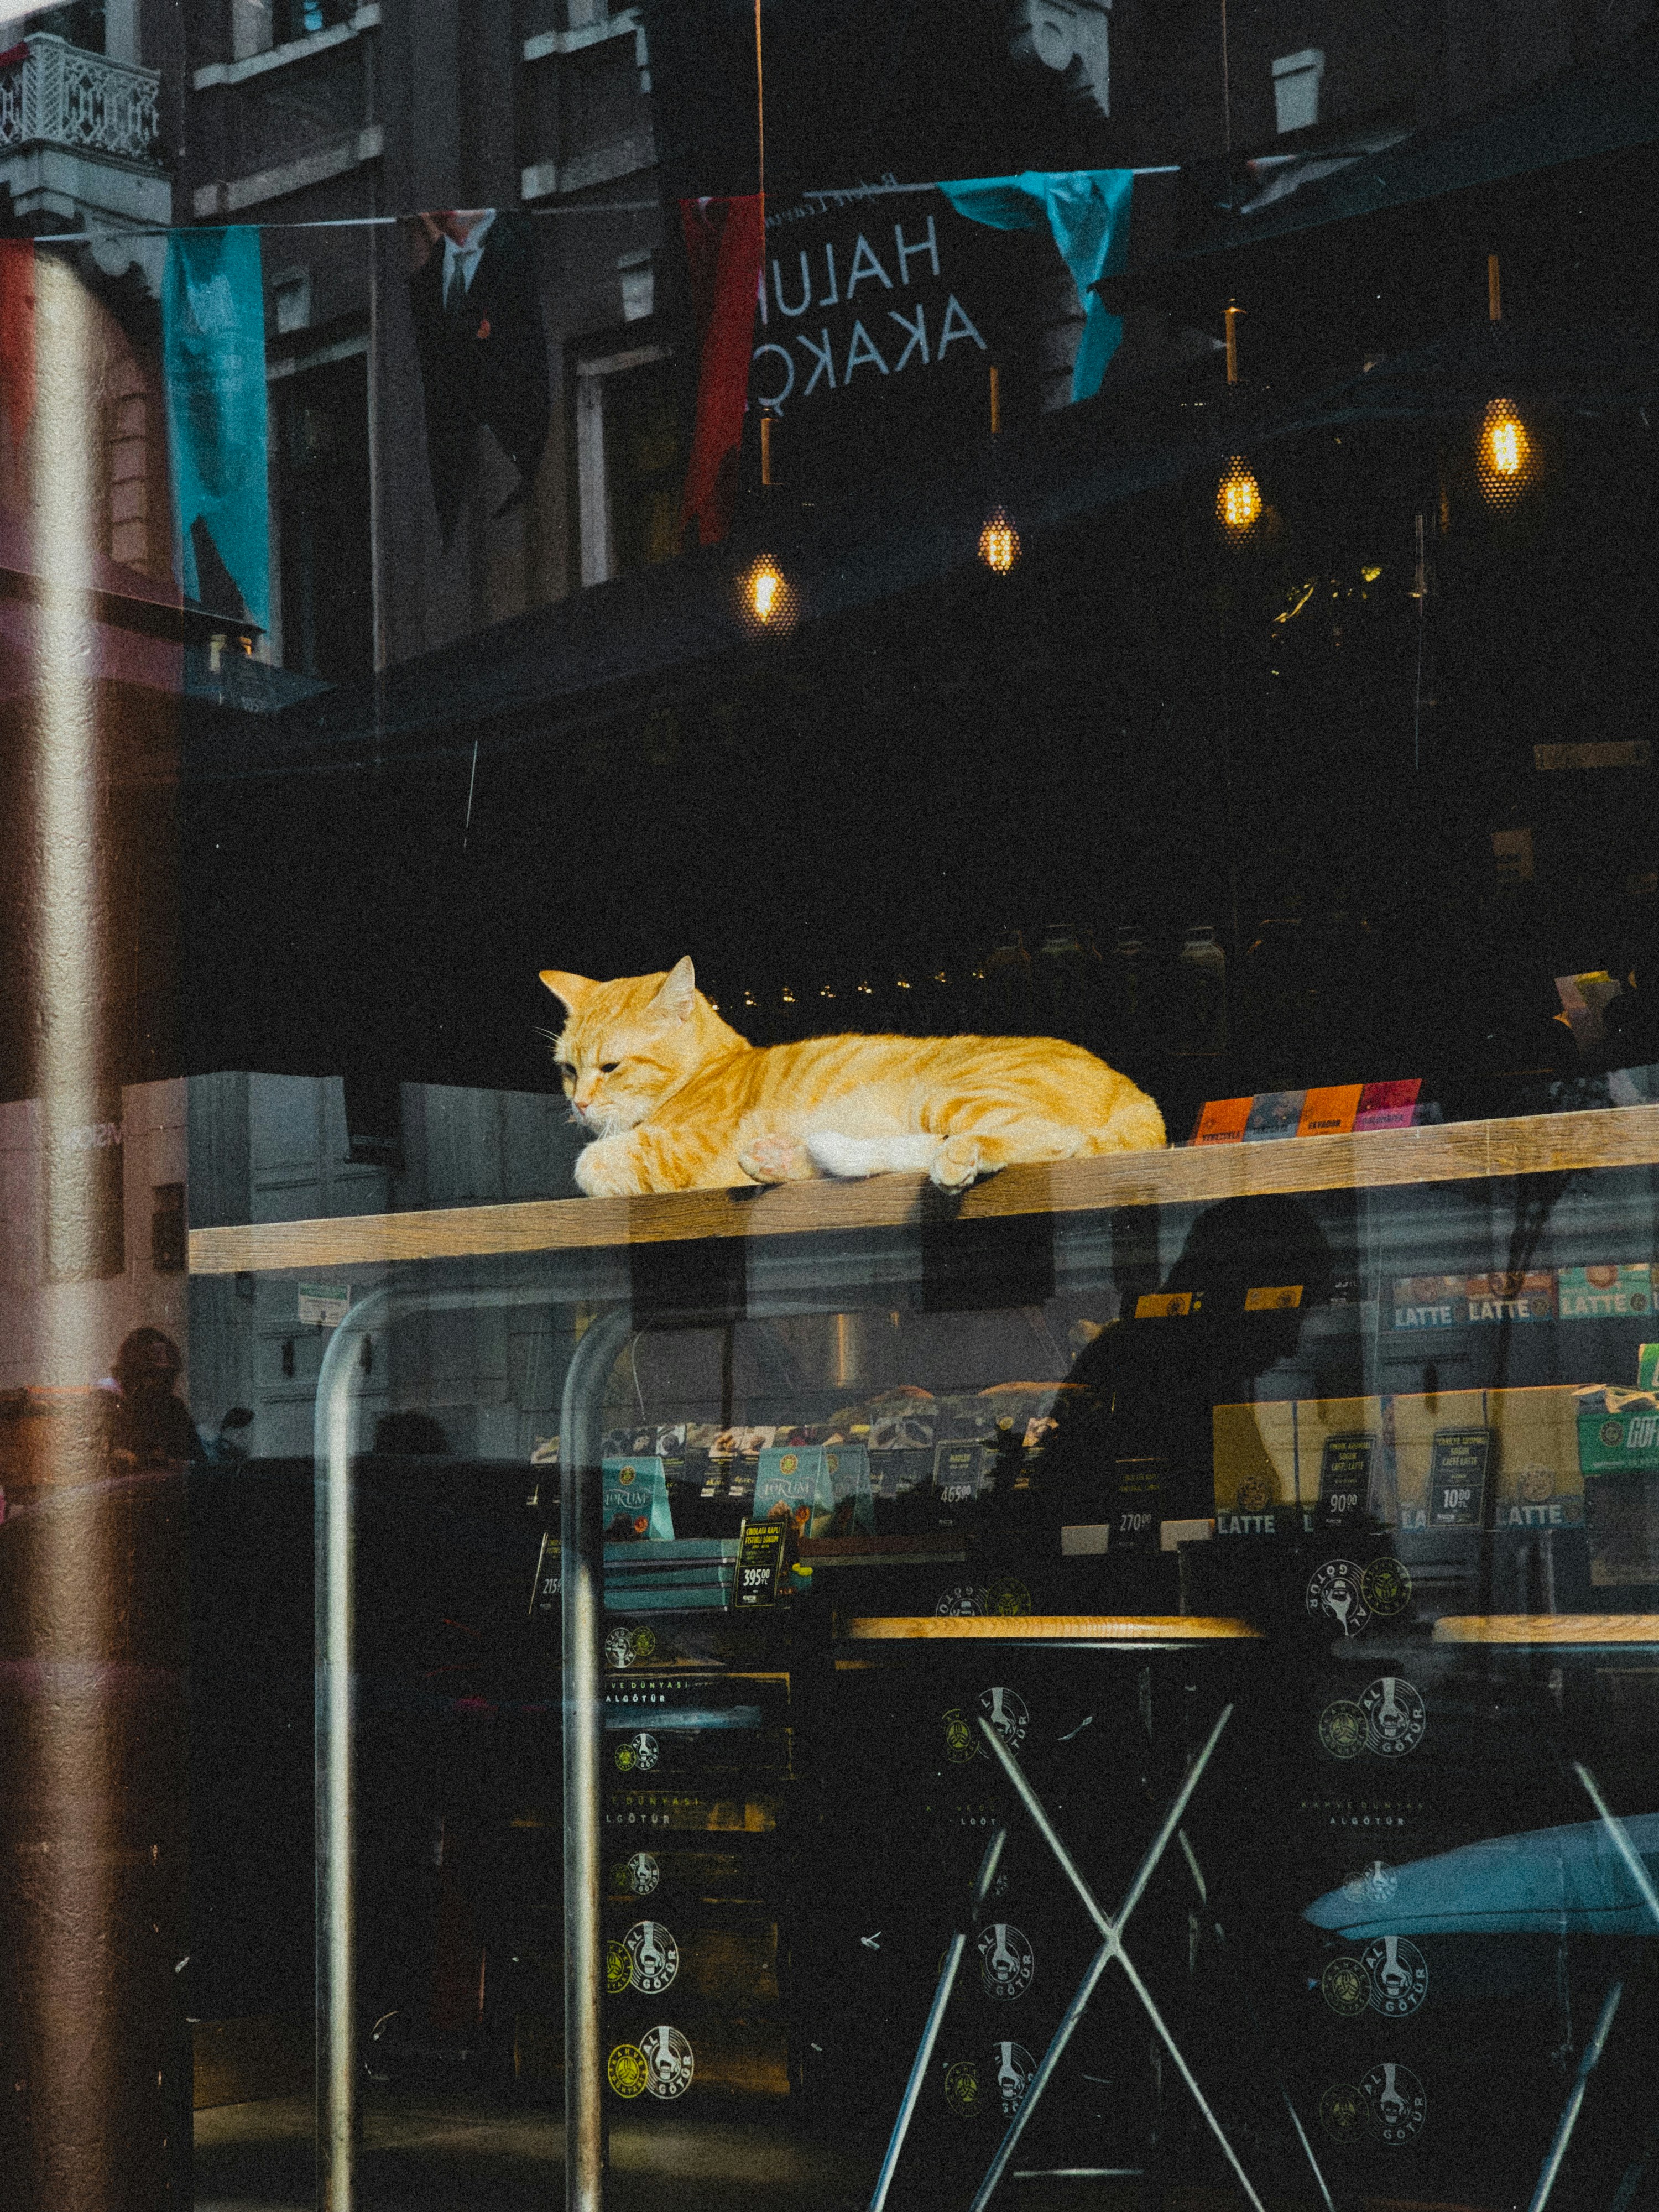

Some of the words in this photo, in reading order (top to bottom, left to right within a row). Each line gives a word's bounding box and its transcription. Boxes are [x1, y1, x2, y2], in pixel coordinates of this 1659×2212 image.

[1468, 1300, 1530, 1321] LATTE
[1560, 1293, 1627, 1316] LATTE
[1396, 1306, 1451, 1326] LATTE
[1218, 1515, 1275, 1534] LATTE
[628, 1932, 643, 1950] AL
[978, 1934, 994, 1955] AL
[1366, 1947, 1384, 1969] AL
[643, 2035, 658, 2056] AL
[1364, 2075, 1381, 2096] AL
